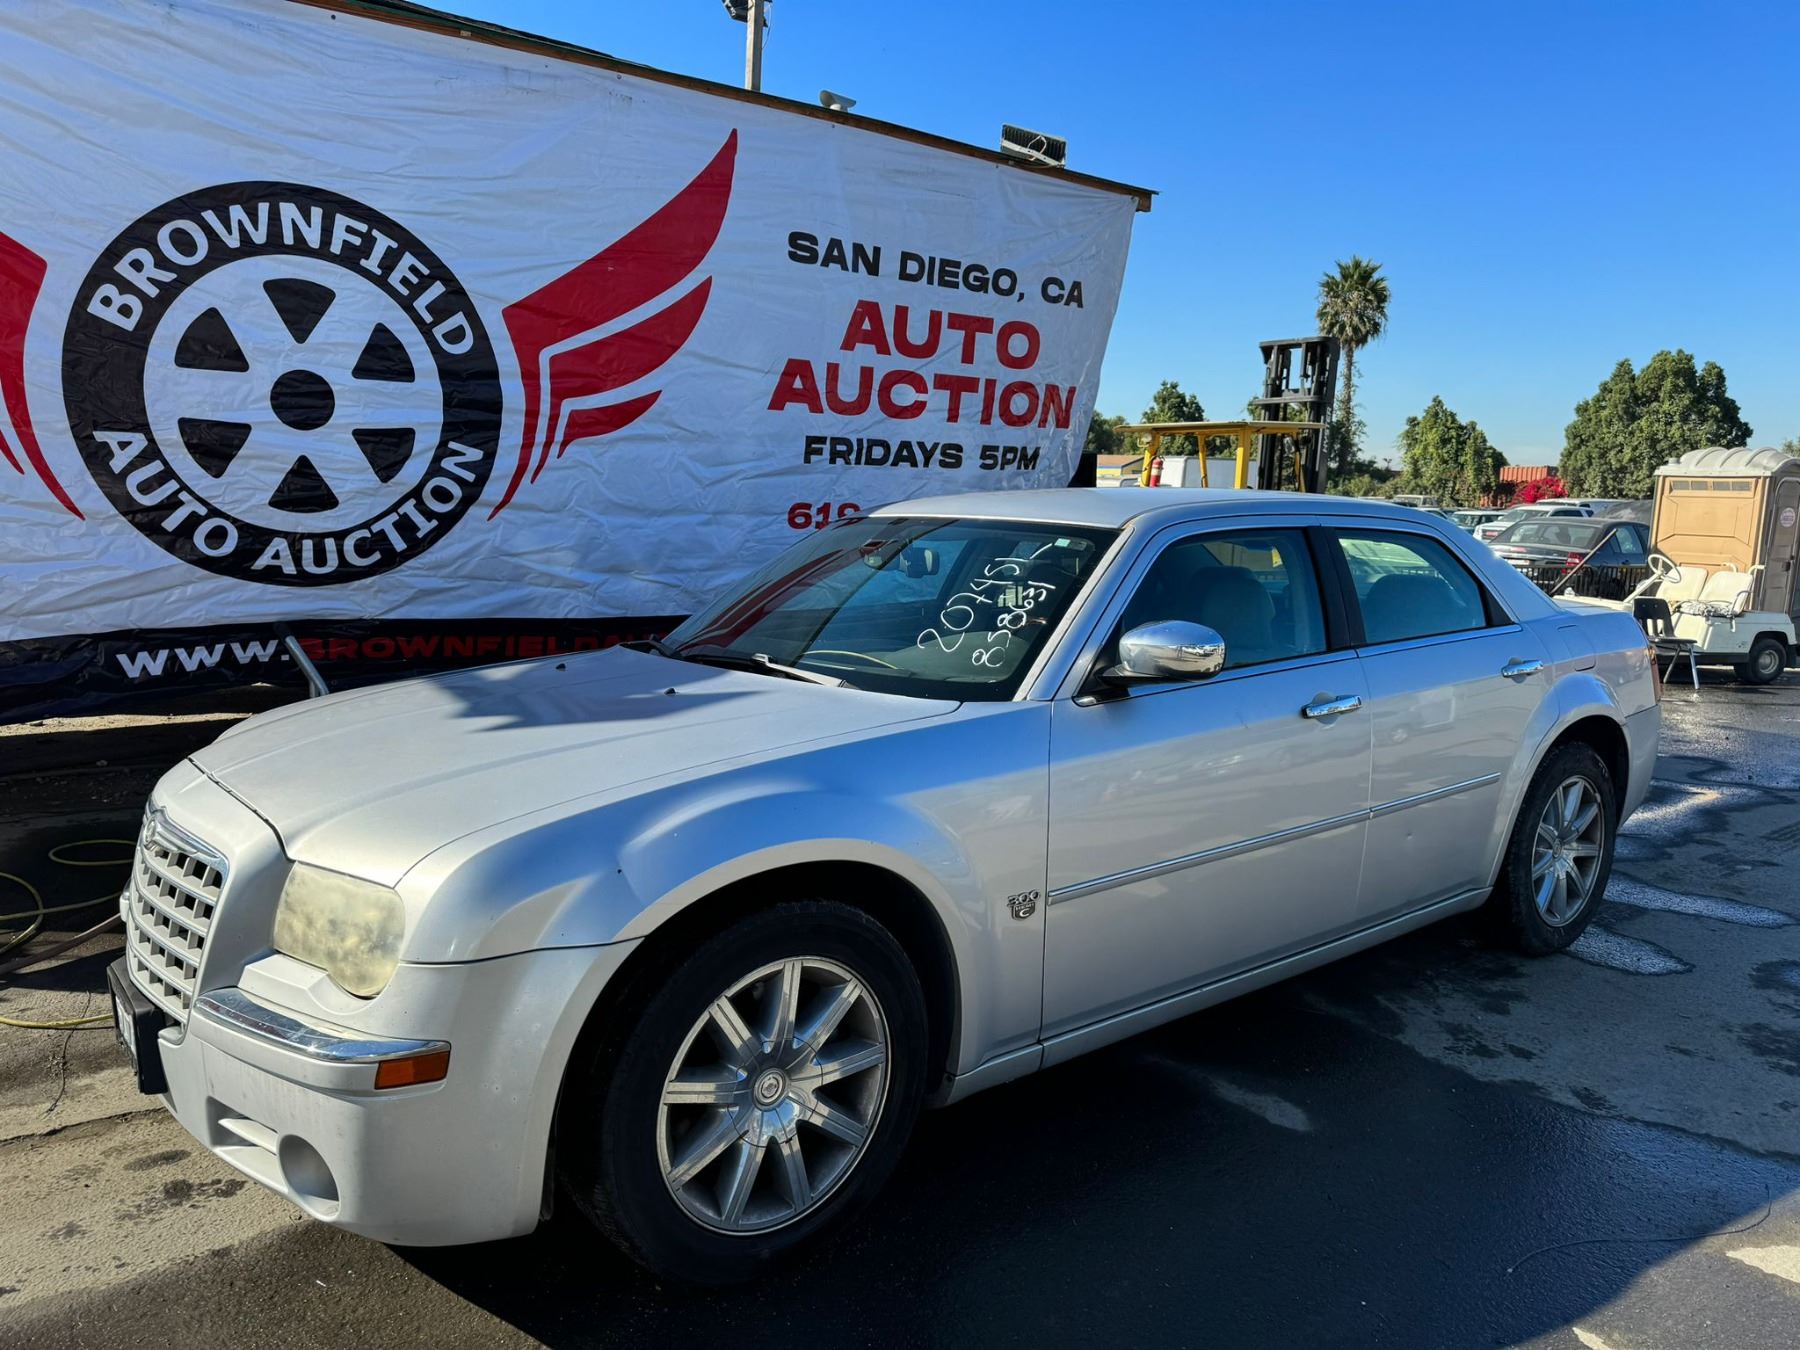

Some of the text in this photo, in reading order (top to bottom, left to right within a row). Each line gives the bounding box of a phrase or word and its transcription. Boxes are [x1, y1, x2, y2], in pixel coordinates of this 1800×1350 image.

[87, 201, 475, 355] BROWNFIELD
[788, 231, 1084, 308] SAN DIEGO, CA
[840, 299, 1041, 370] AUTO
[767, 358, 1077, 429] AUCTION
[803, 435, 1041, 471] FRIDAYS 5PM
[92, 430, 484, 575] AUTO AUCTION
[1007, 888, 1041, 907] 300
